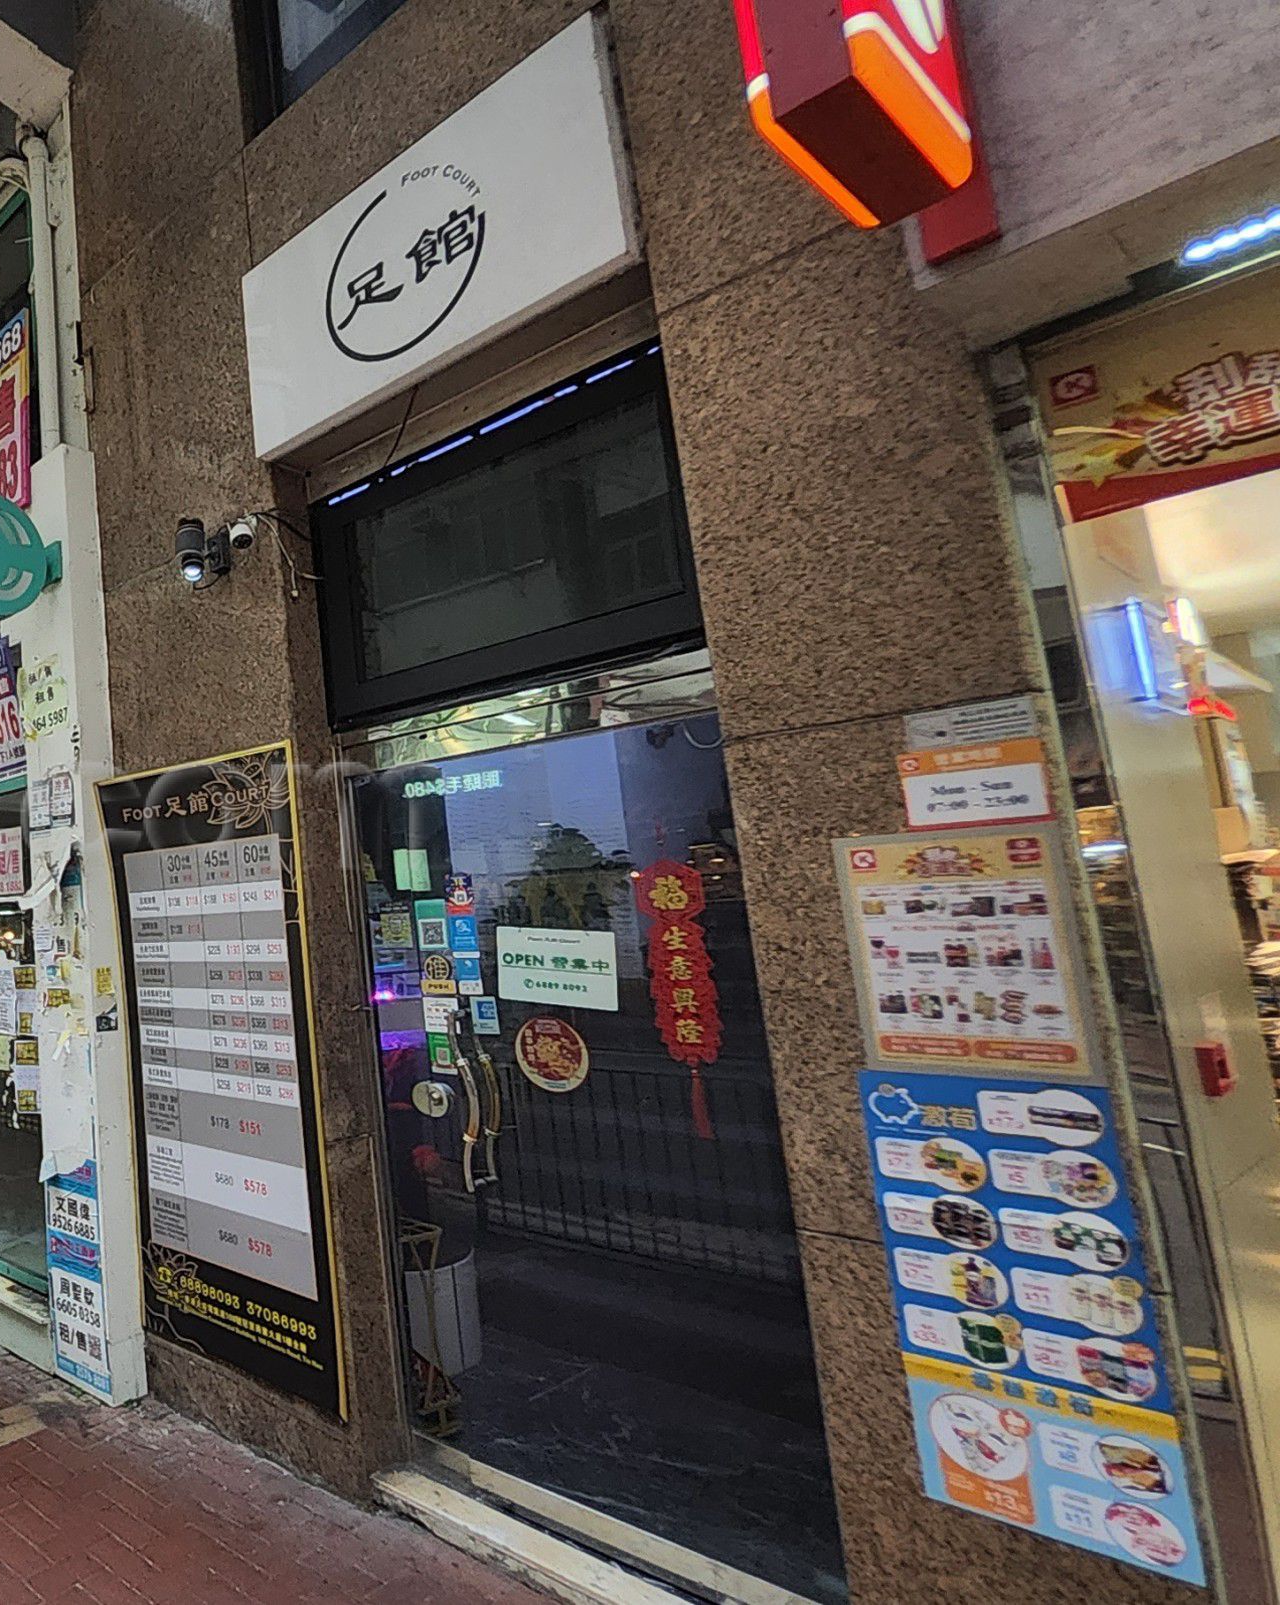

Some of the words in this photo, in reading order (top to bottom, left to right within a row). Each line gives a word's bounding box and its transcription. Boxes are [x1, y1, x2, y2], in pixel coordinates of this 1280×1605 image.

[338, 205, 476, 330] 足館
[164, 793, 210, 818] 足館
[167, 854, 181, 872] 30
[204, 850, 219, 868] 45
[243, 845, 259, 864] 60
[502, 952, 545, 967] OPEN
